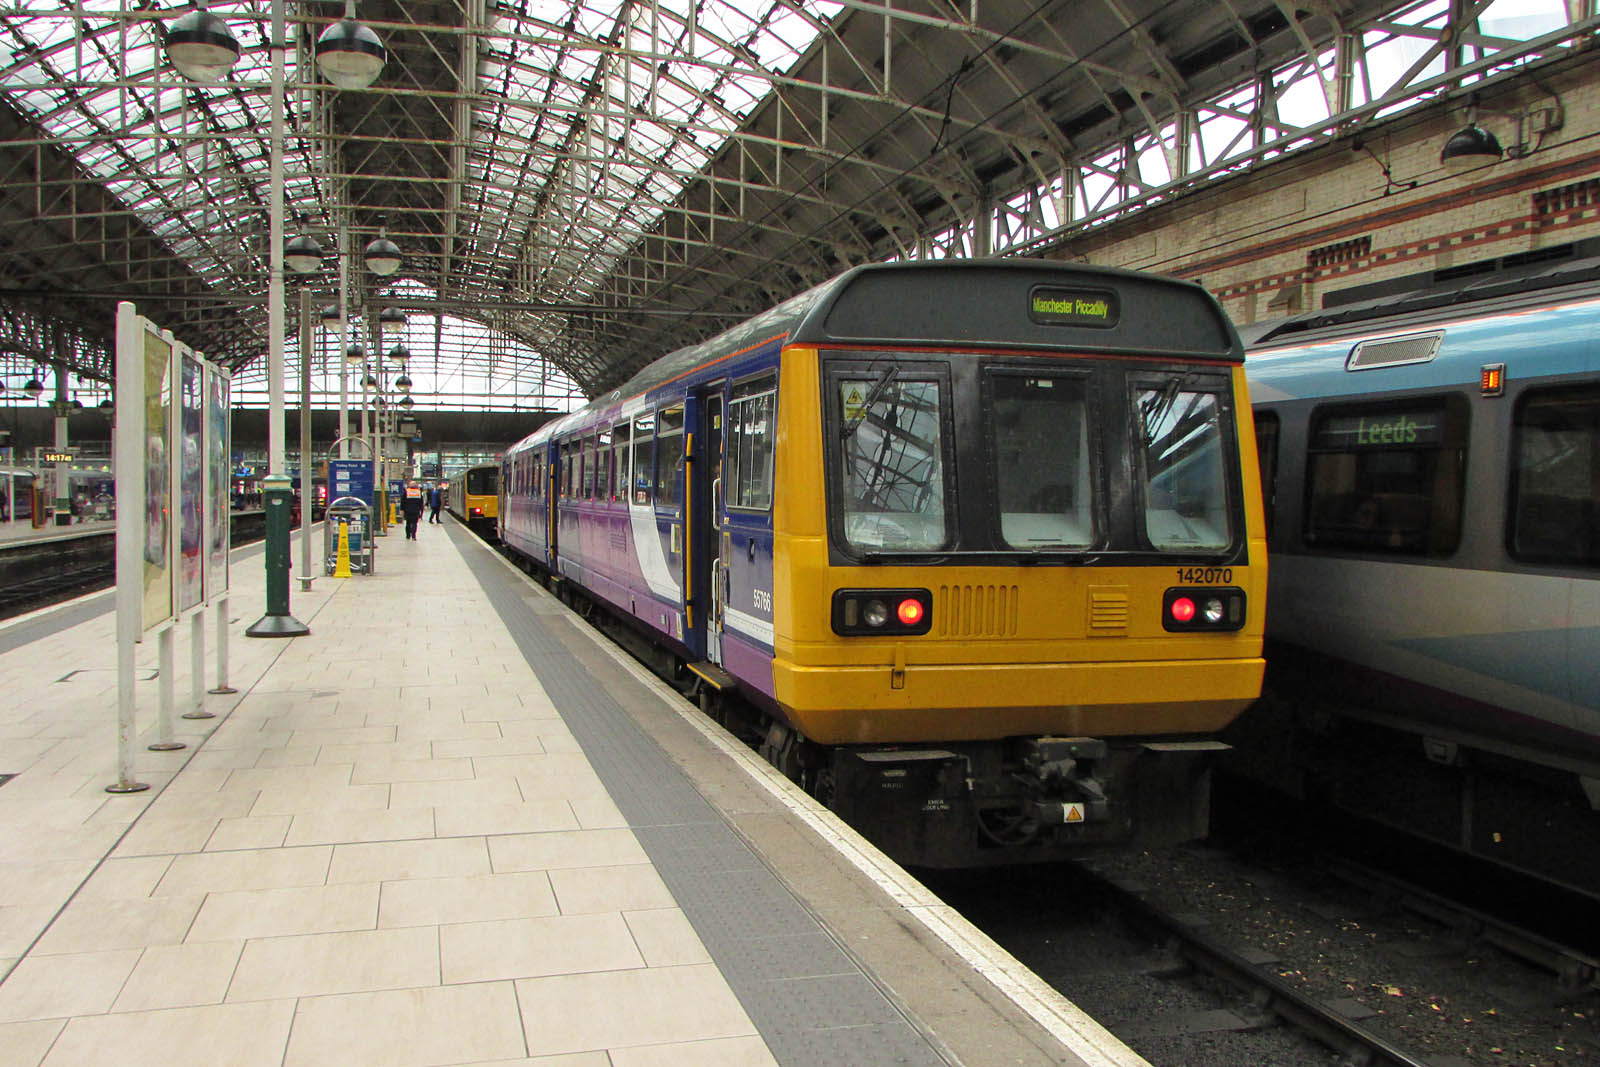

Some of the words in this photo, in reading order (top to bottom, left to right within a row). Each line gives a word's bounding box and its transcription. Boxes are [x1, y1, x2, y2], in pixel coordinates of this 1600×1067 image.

[1033, 297, 1072, 313] Manchester
[1075, 299, 1107, 319] Piccadilly
[1358, 416, 1416, 444] Leeds
[1177, 568, 1232, 584] 142070
[753, 588, 771, 612] 55766
